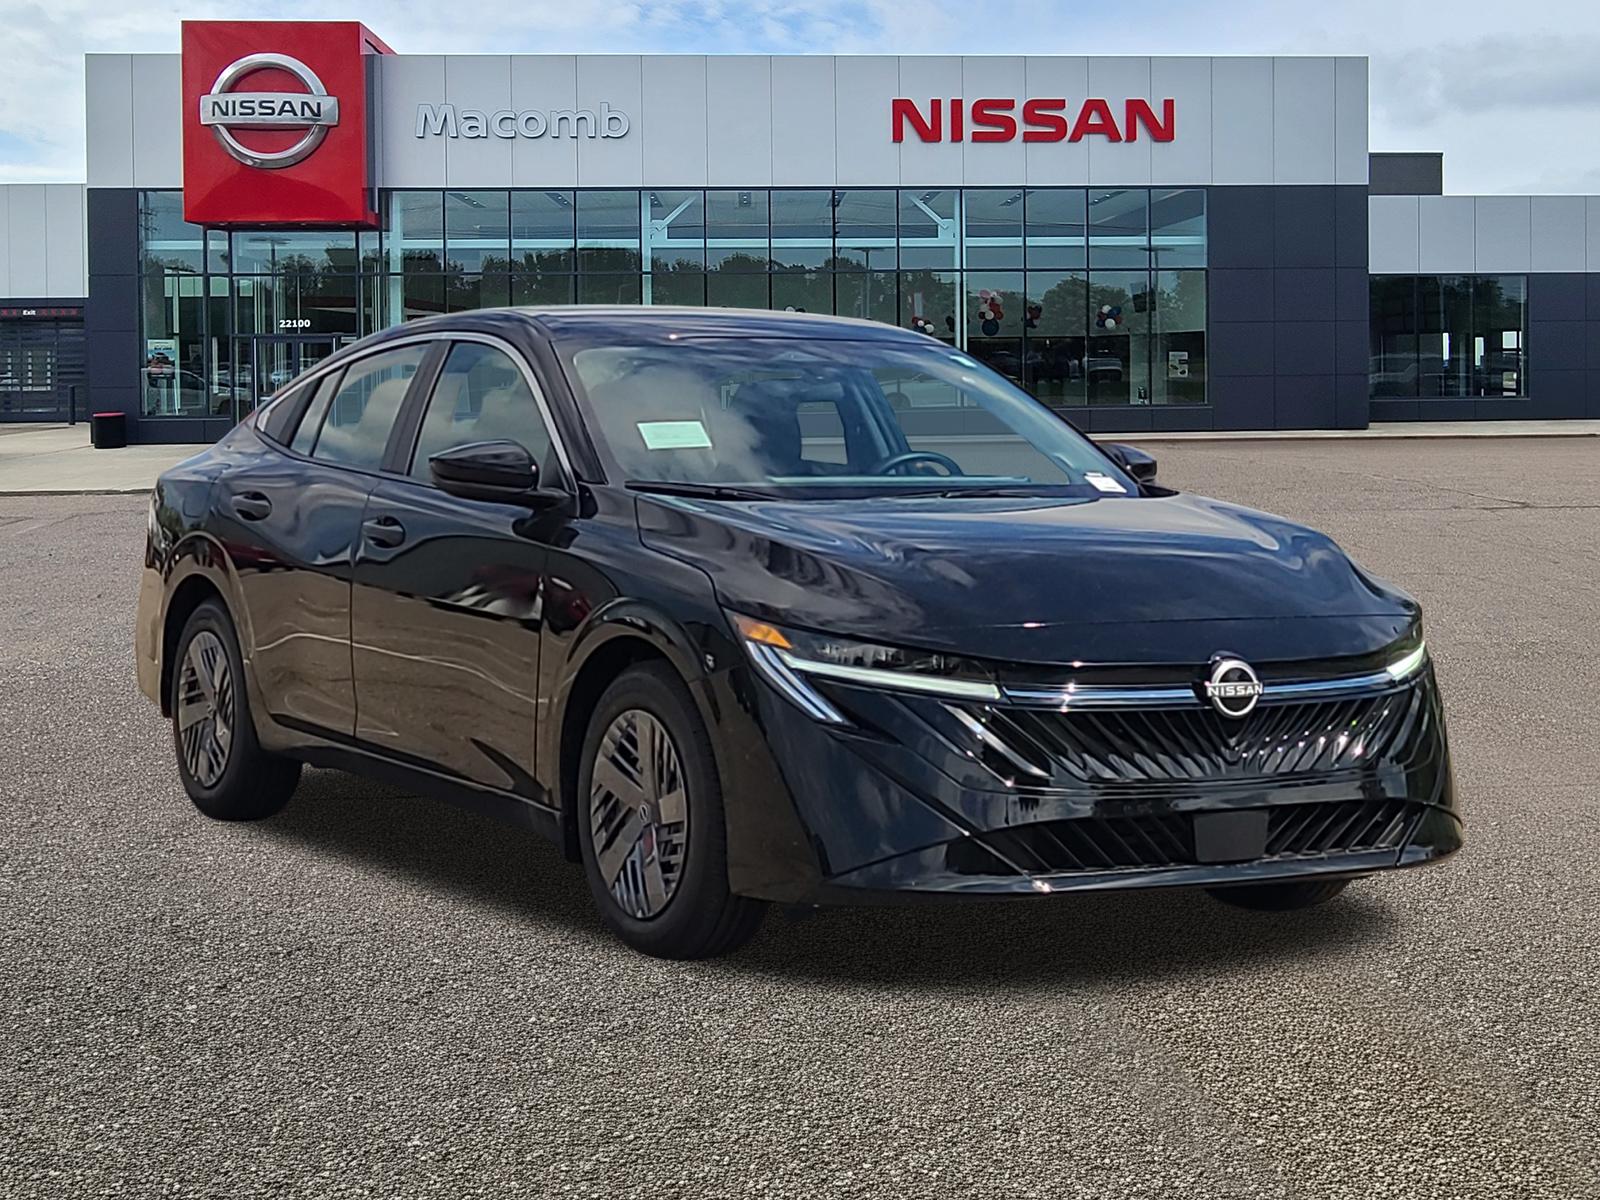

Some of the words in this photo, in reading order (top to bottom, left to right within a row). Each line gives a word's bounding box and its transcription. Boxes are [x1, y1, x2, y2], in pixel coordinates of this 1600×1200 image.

[212, 100, 322, 117] NISSAN
[415, 102, 630, 139] Macomb
[891, 98, 1176, 143] NISSAN
[279, 319, 311, 328] 22100
[1207, 685, 1263, 697] NISSAN
